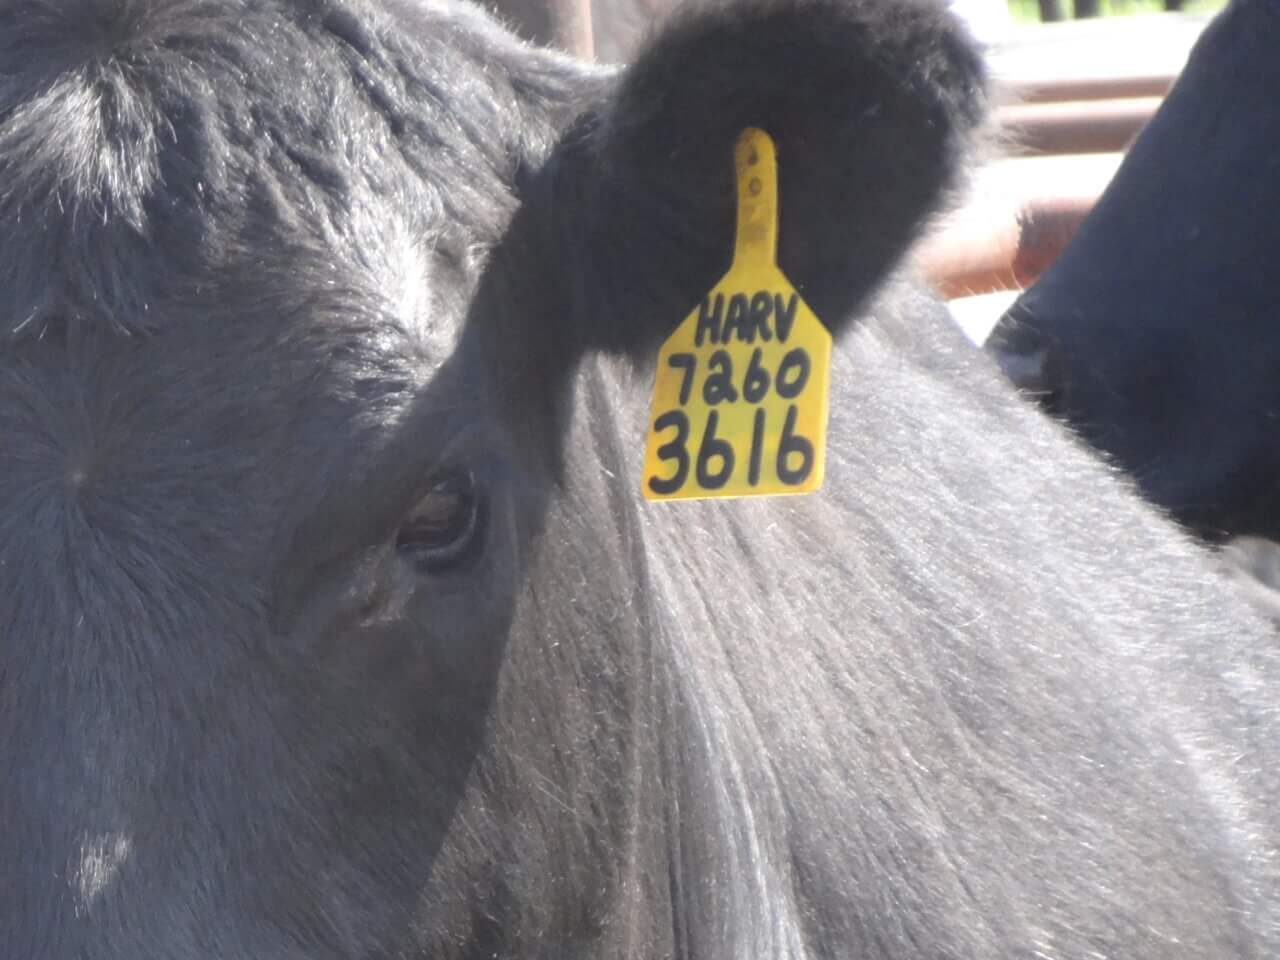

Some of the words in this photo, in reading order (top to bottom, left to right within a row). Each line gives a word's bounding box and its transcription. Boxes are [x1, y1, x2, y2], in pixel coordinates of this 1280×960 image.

[695, 291, 798, 347] HARV
[668, 348, 811, 406] 7260
[648, 405, 815, 494] 3616
